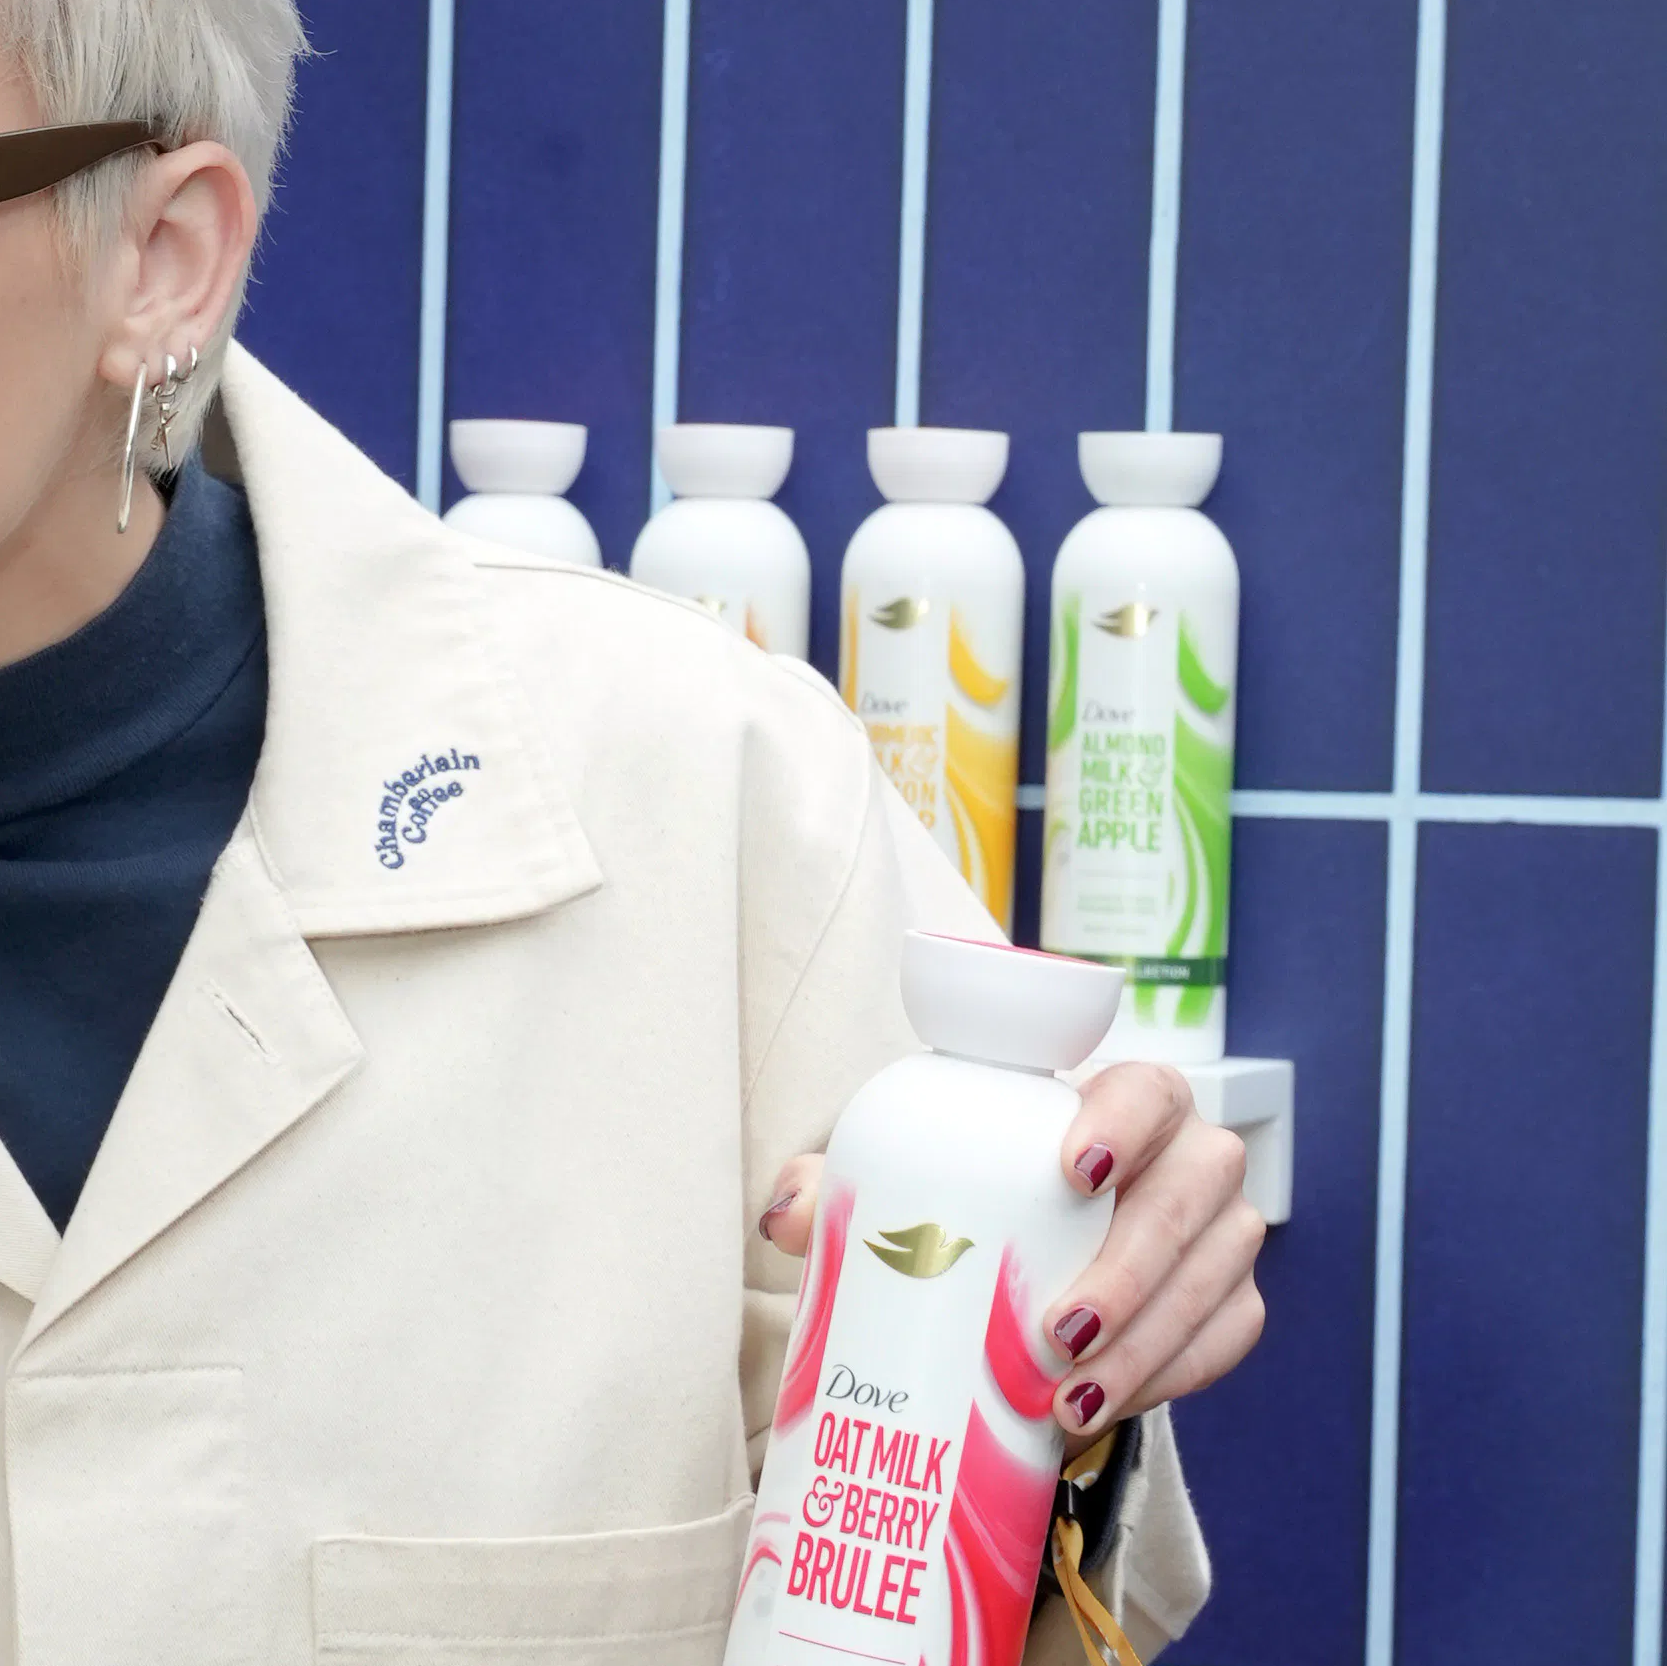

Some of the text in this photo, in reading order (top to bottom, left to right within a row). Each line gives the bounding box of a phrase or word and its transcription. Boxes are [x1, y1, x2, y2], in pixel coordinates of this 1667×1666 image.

[1081, 756, 1133, 786] MILK
[1082, 731, 1167, 758] ALMOND
[374, 747, 481, 870] Chamberlain
[401, 780, 464, 845] Coffee
[1079, 787, 1165, 818] GREEN
[1077, 819, 1162, 854] APPLE
[825, 1363, 910, 1414] Dove
[813, 1410, 951, 1495] OAT MILK
[802, 1475, 940, 1552] & BERRY
[786, 1531, 928, 1625] BRULEE
